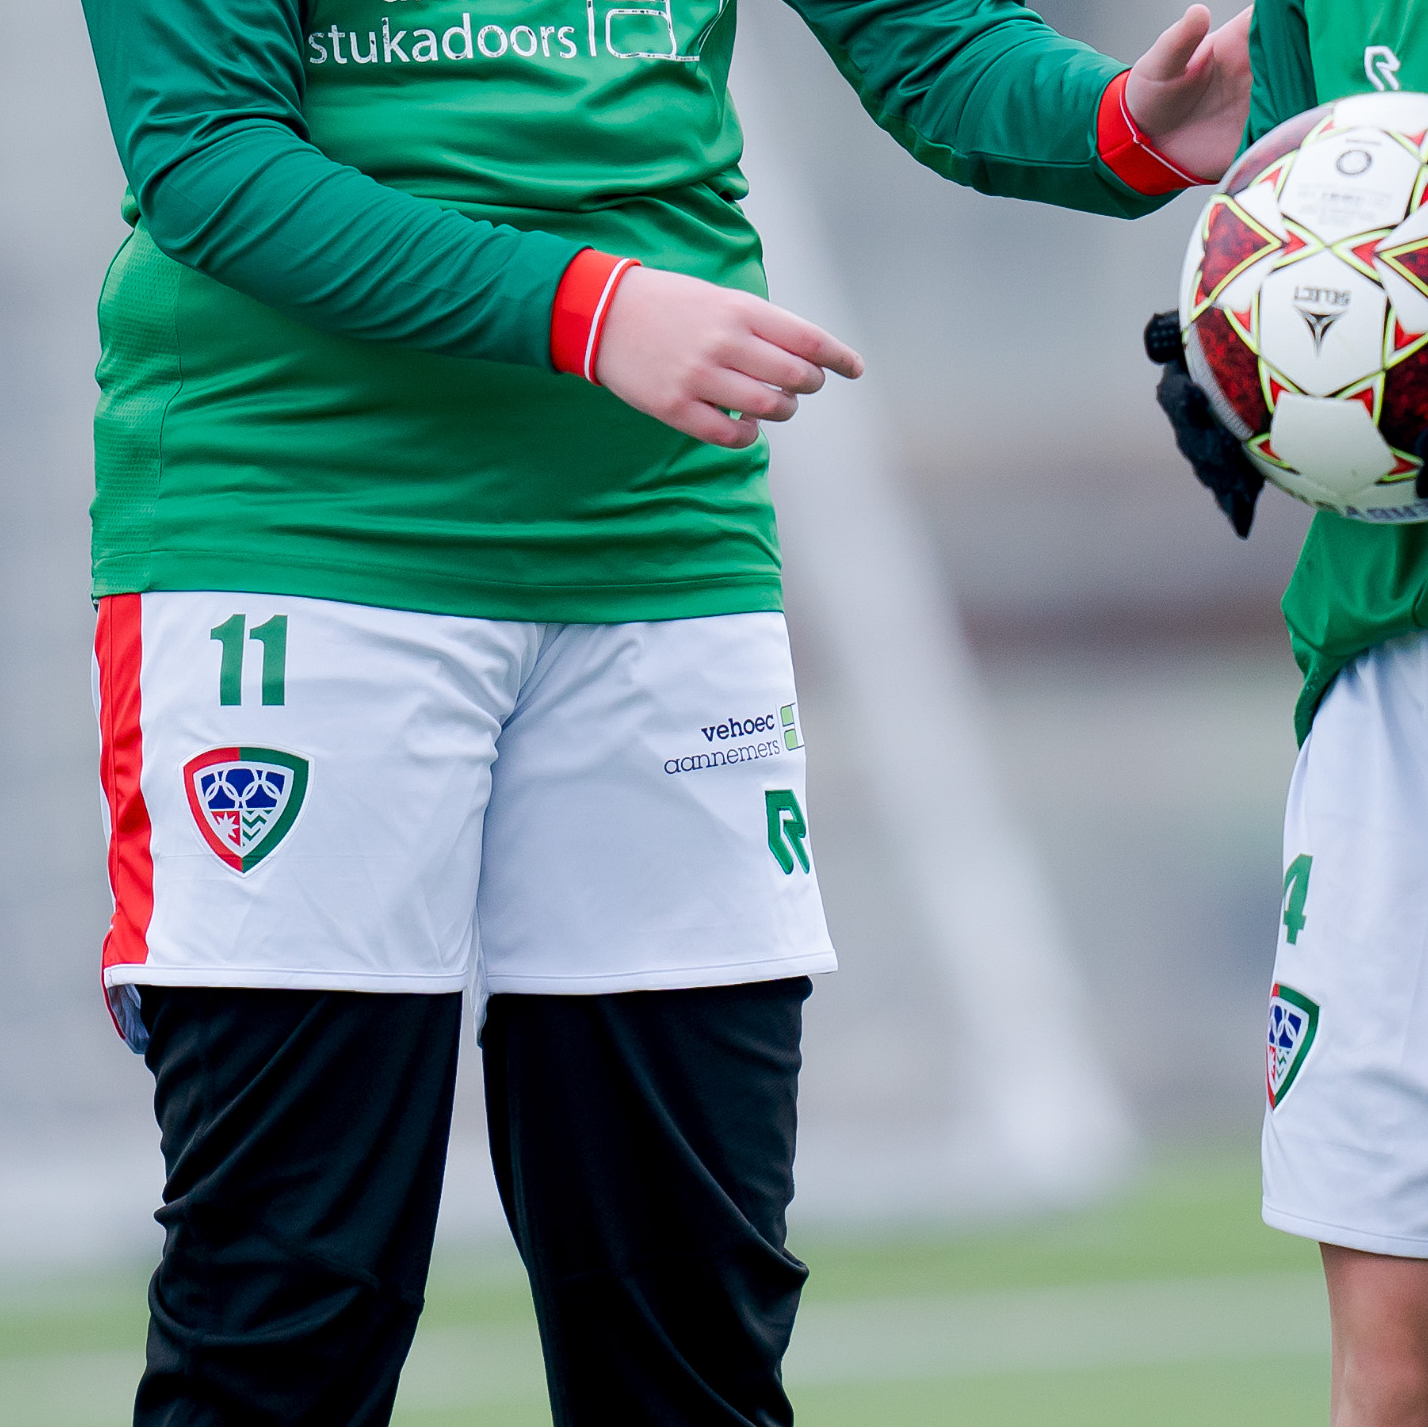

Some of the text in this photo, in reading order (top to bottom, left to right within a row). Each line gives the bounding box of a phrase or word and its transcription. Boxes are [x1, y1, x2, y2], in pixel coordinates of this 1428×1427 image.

[309, 13, 578, 64] stukadoors
[210, 613, 287, 706] 11
[701, 714, 775, 742] vehoec
[664, 740, 780, 775] aannemers
